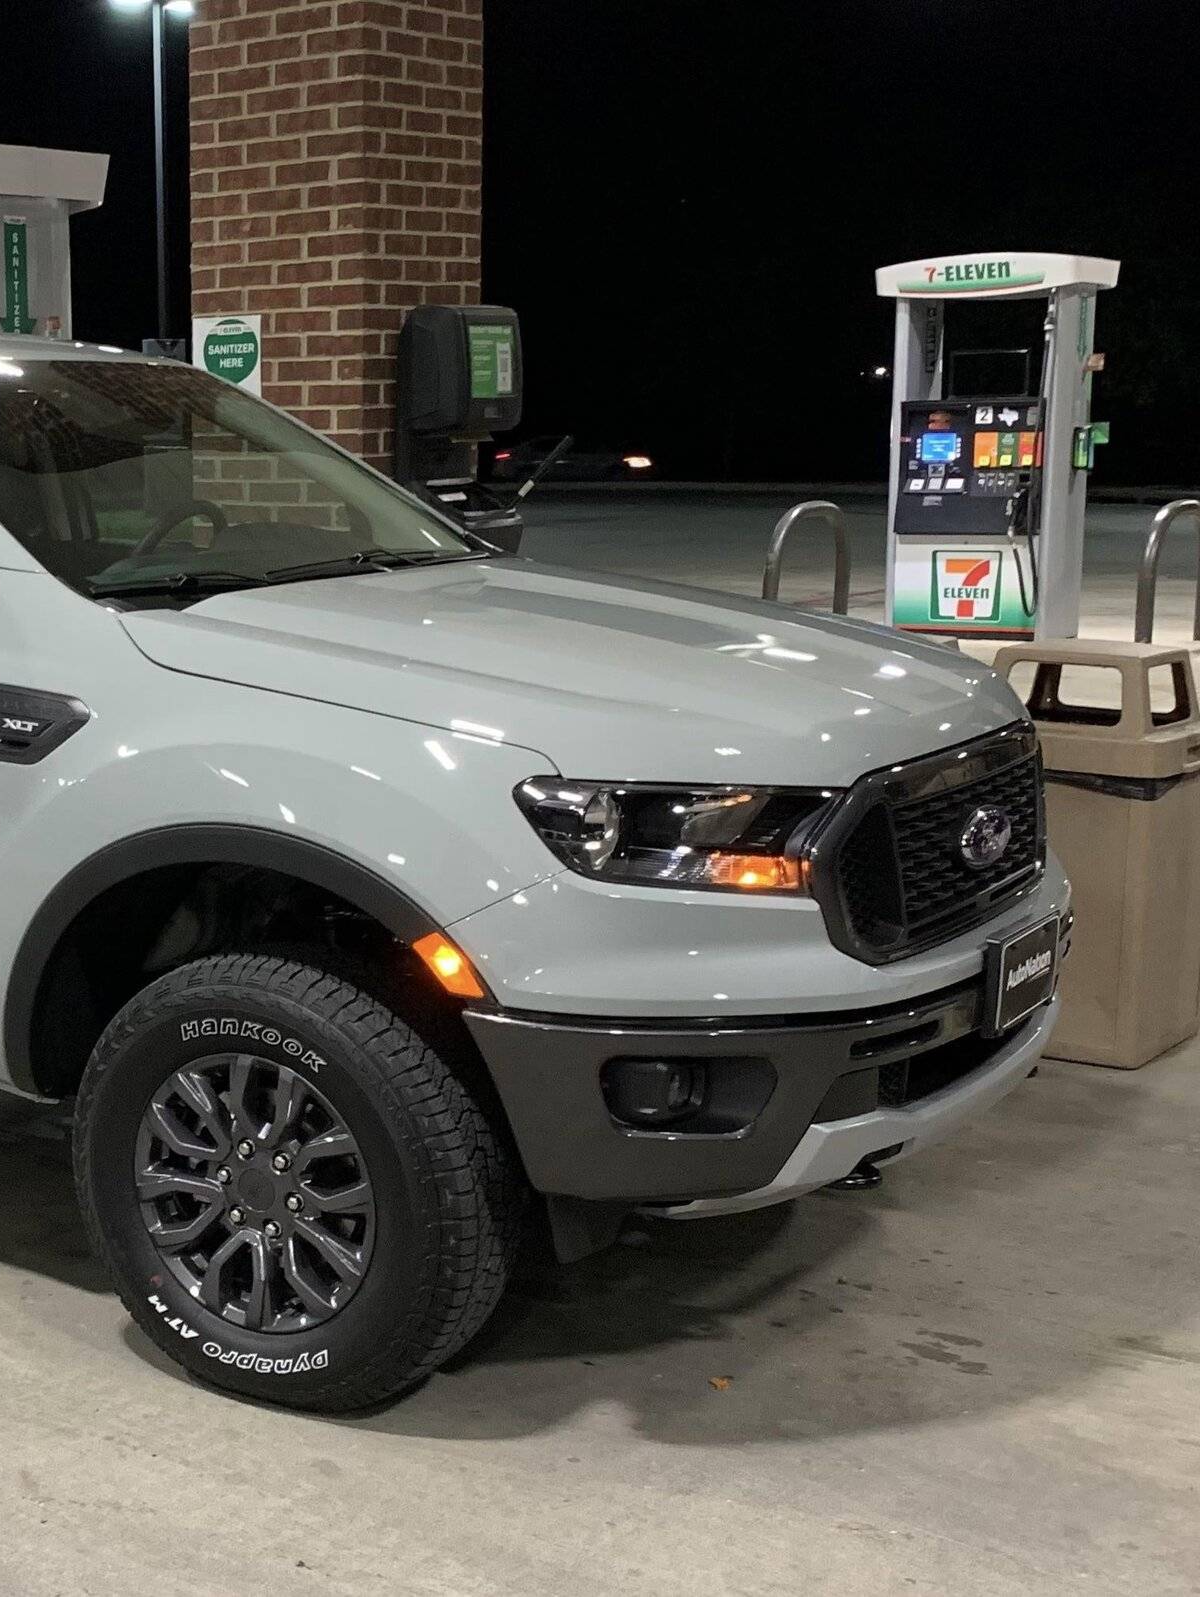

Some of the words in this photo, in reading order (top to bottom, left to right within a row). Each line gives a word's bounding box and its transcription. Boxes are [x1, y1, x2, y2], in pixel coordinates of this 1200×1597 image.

[208, 343, 255, 355] SANITIZER
[219, 358, 244, 368] HERE
[979, 408, 990, 422] 2
[2, 718, 39, 732] XLT
[1006, 950, 1051, 991] AutoNation
[202, 1341, 329, 1375] Dynapro
